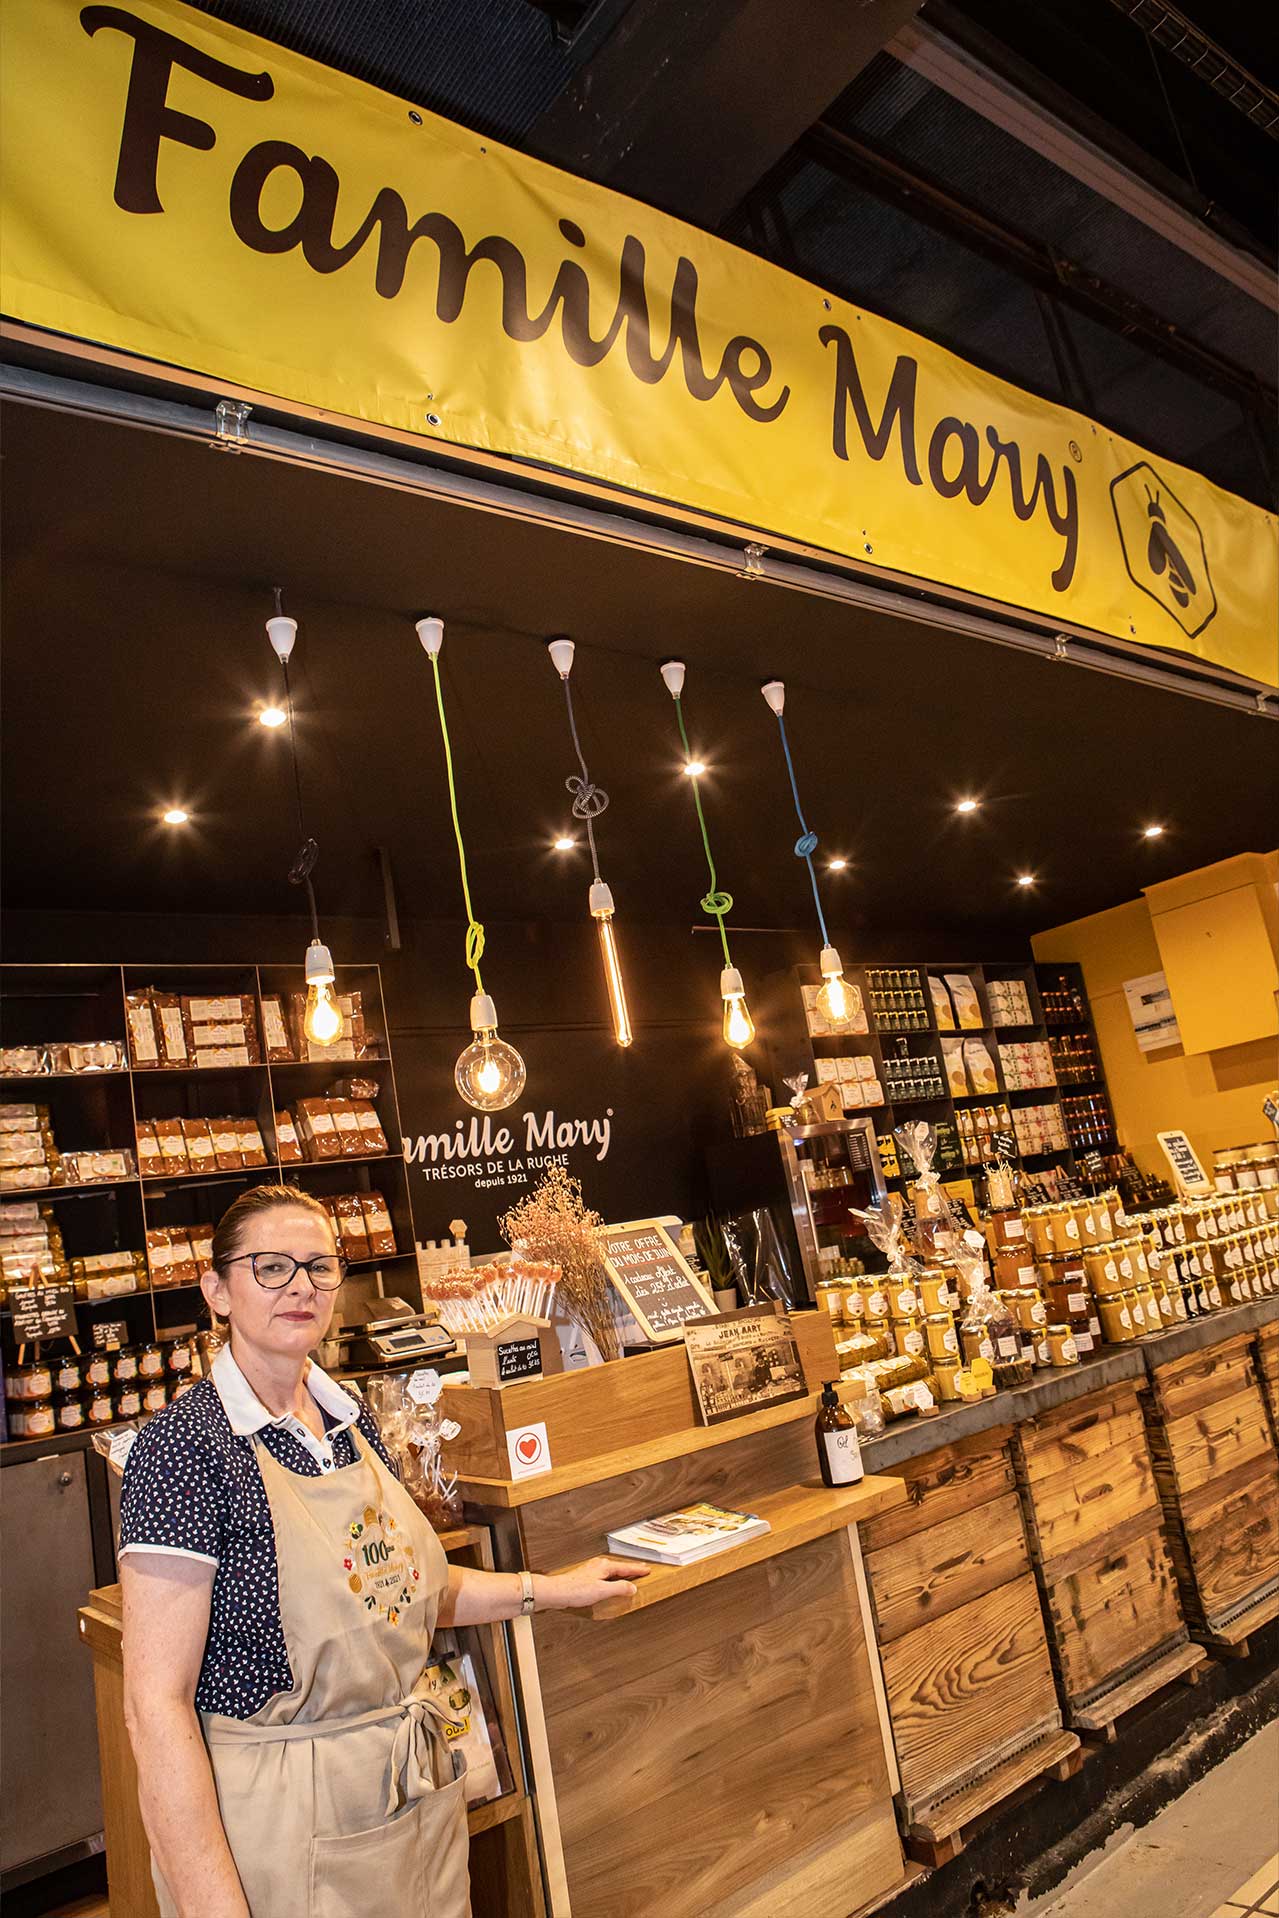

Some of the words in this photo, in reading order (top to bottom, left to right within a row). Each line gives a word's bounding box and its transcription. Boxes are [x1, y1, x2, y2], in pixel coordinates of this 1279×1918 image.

[79, 4, 791, 424] Famille
[422, 1163, 483, 1181] TRÉSORS
[487, 1161, 505, 1173] DE
[508, 1159, 525, 1172] LA
[527, 1153, 570, 1170] RUCHE
[474, 1176, 505, 1189] depuis
[507, 1173, 528, 1185] 1921
[607, 1240, 633, 1255] VOTRE
[634, 1235, 662, 1249] OFFRE
[609, 1256, 624, 1268] DU
[623, 1252, 646, 1265] MOIS
[642, 1250, 655, 1262] DE
[718, 1328, 740, 1339] JEAN
[741, 1324, 761, 1334] MARY
[361, 1539, 389, 1566] 100
